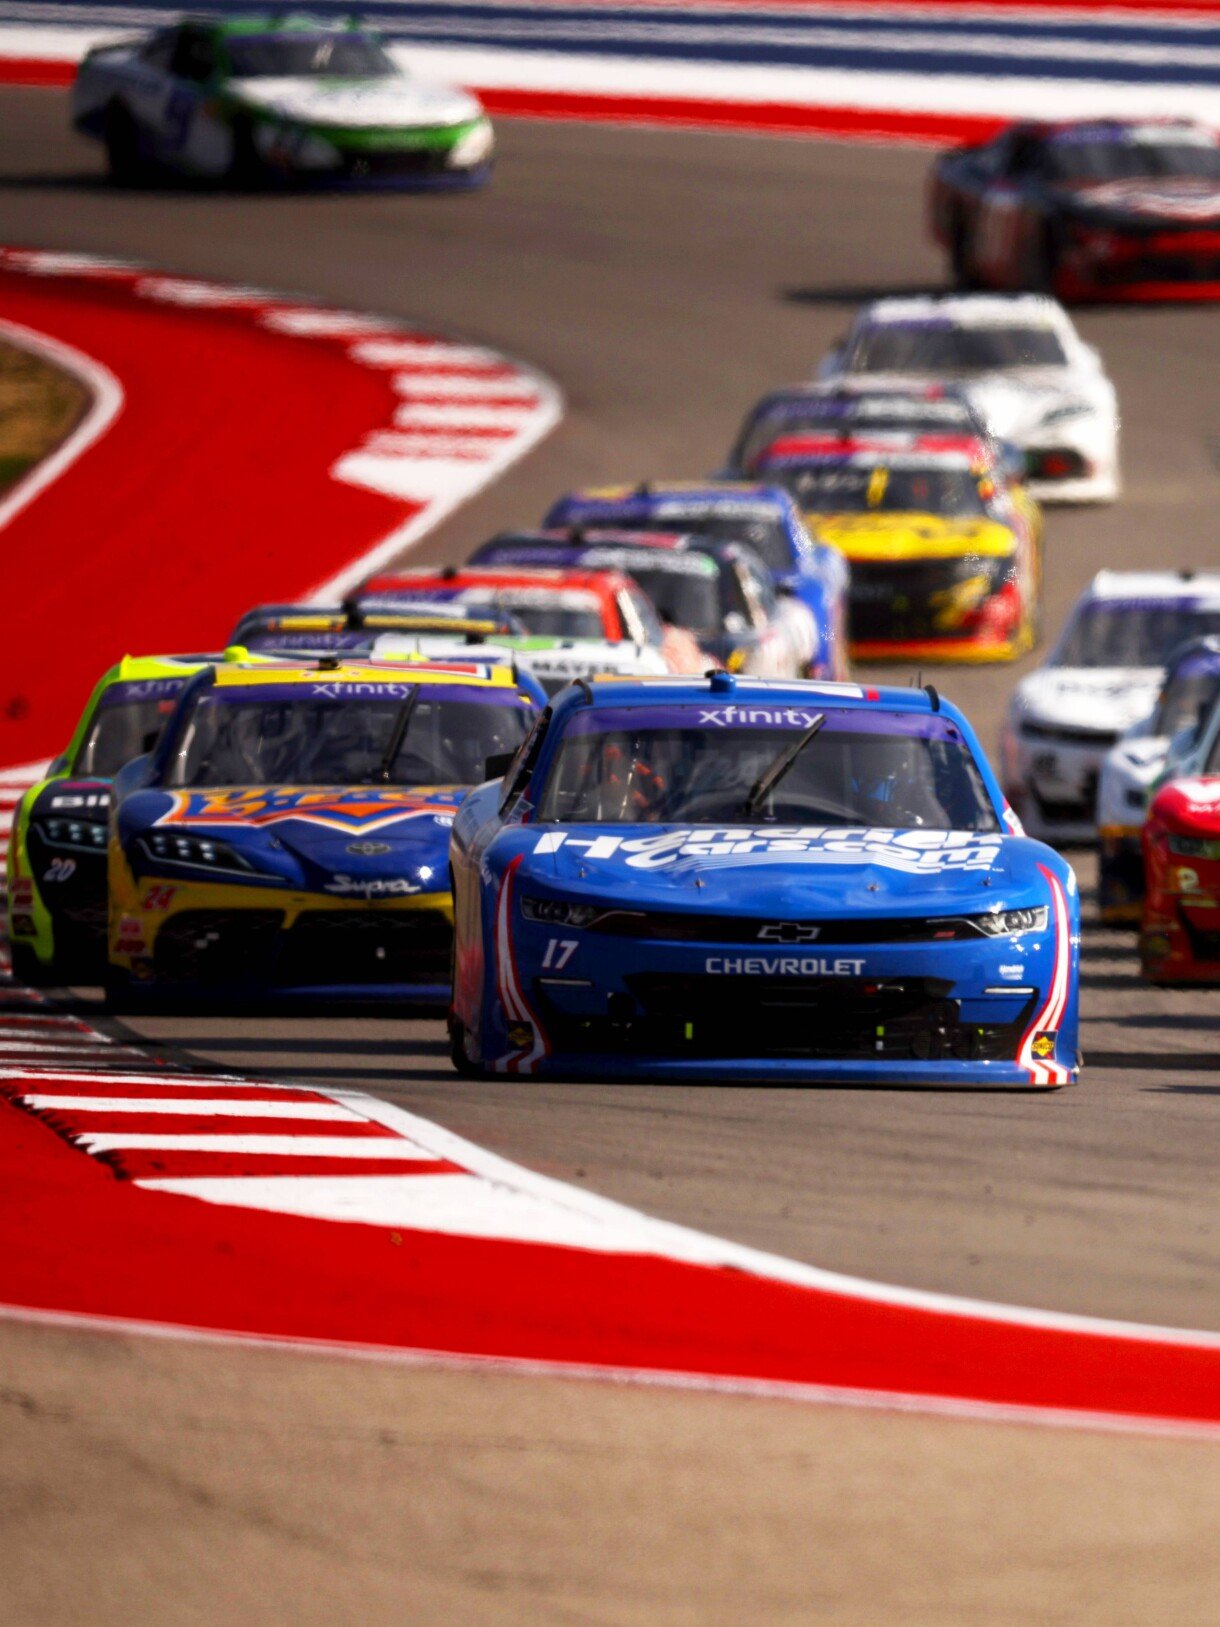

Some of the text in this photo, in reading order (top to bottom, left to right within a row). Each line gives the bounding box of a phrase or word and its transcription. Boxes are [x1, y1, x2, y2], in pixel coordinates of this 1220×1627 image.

[125, 680, 185, 697] xfin
[312, 682, 412, 699] xfinity
[699, 706, 823, 729] xfinity
[43, 857, 77, 882] 20
[143, 884, 178, 911] 24
[323, 874, 422, 898] Supra
[542, 939, 580, 969] 17
[705, 957, 866, 976] CHEVROLET
